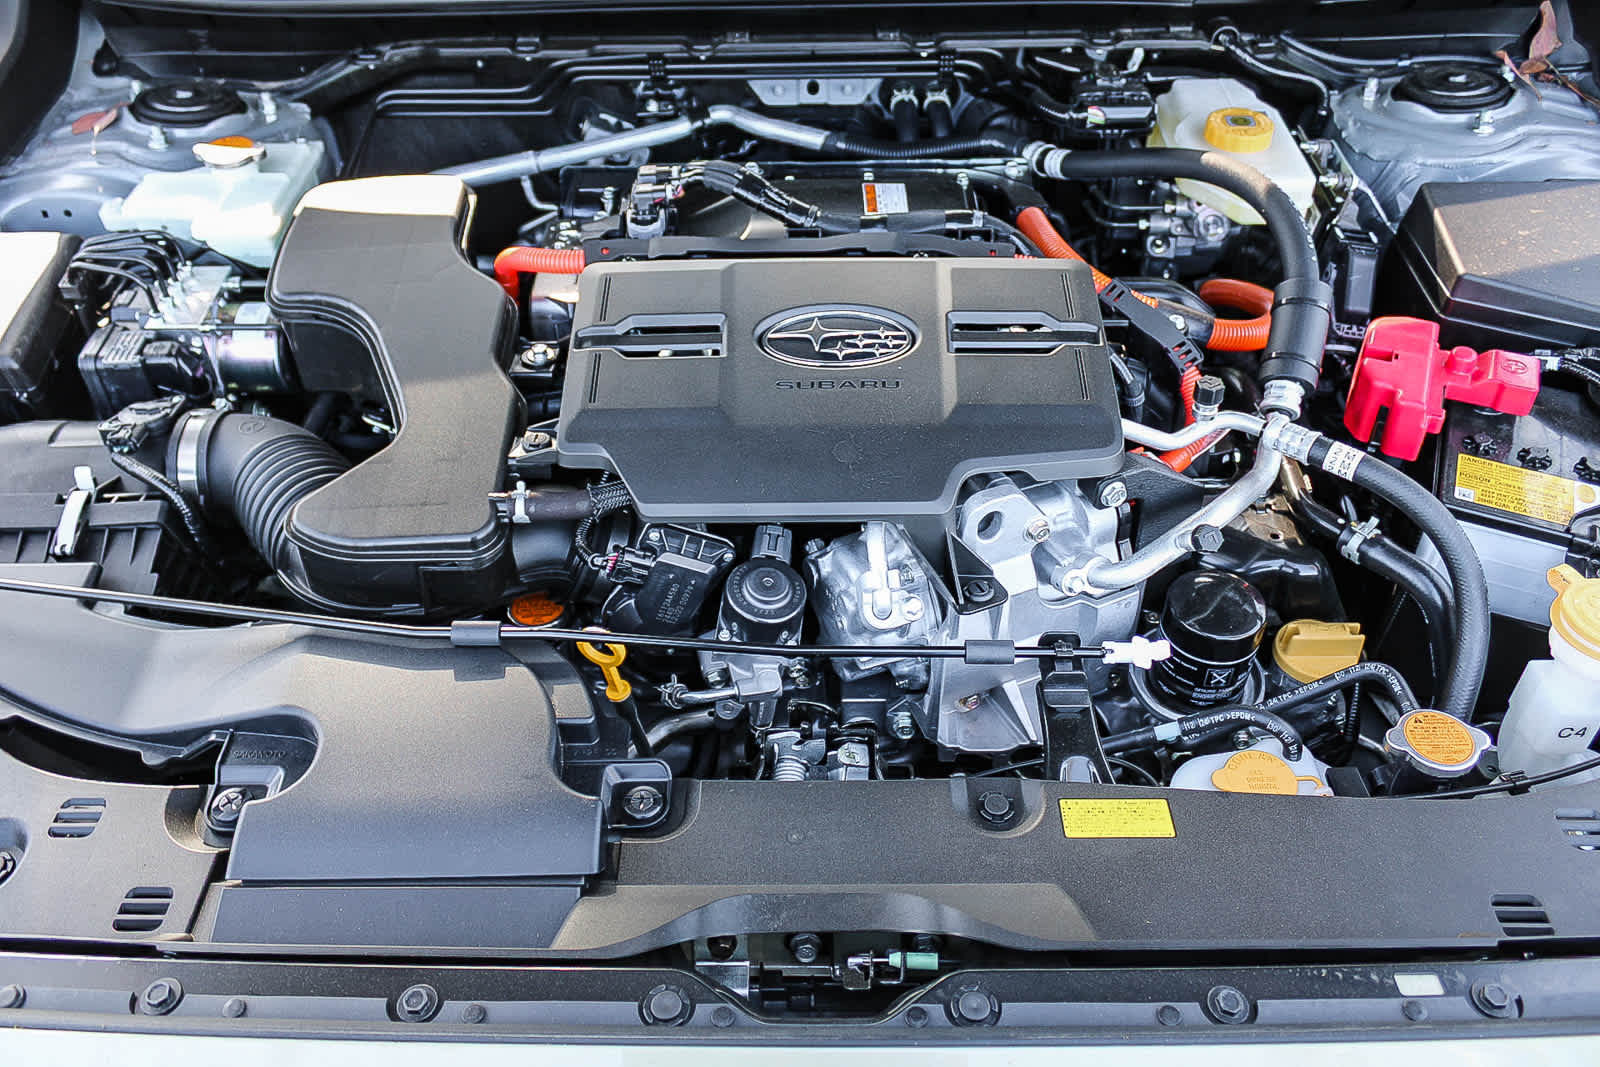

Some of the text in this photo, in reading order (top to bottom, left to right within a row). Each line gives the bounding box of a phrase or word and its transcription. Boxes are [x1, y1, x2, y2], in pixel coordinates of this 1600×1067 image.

[775, 380, 900, 390] SUBARU
[1461, 456, 1494, 467] DANGER
[1459, 472, 1491, 483] POISON
[1558, 727, 1587, 738] C4
